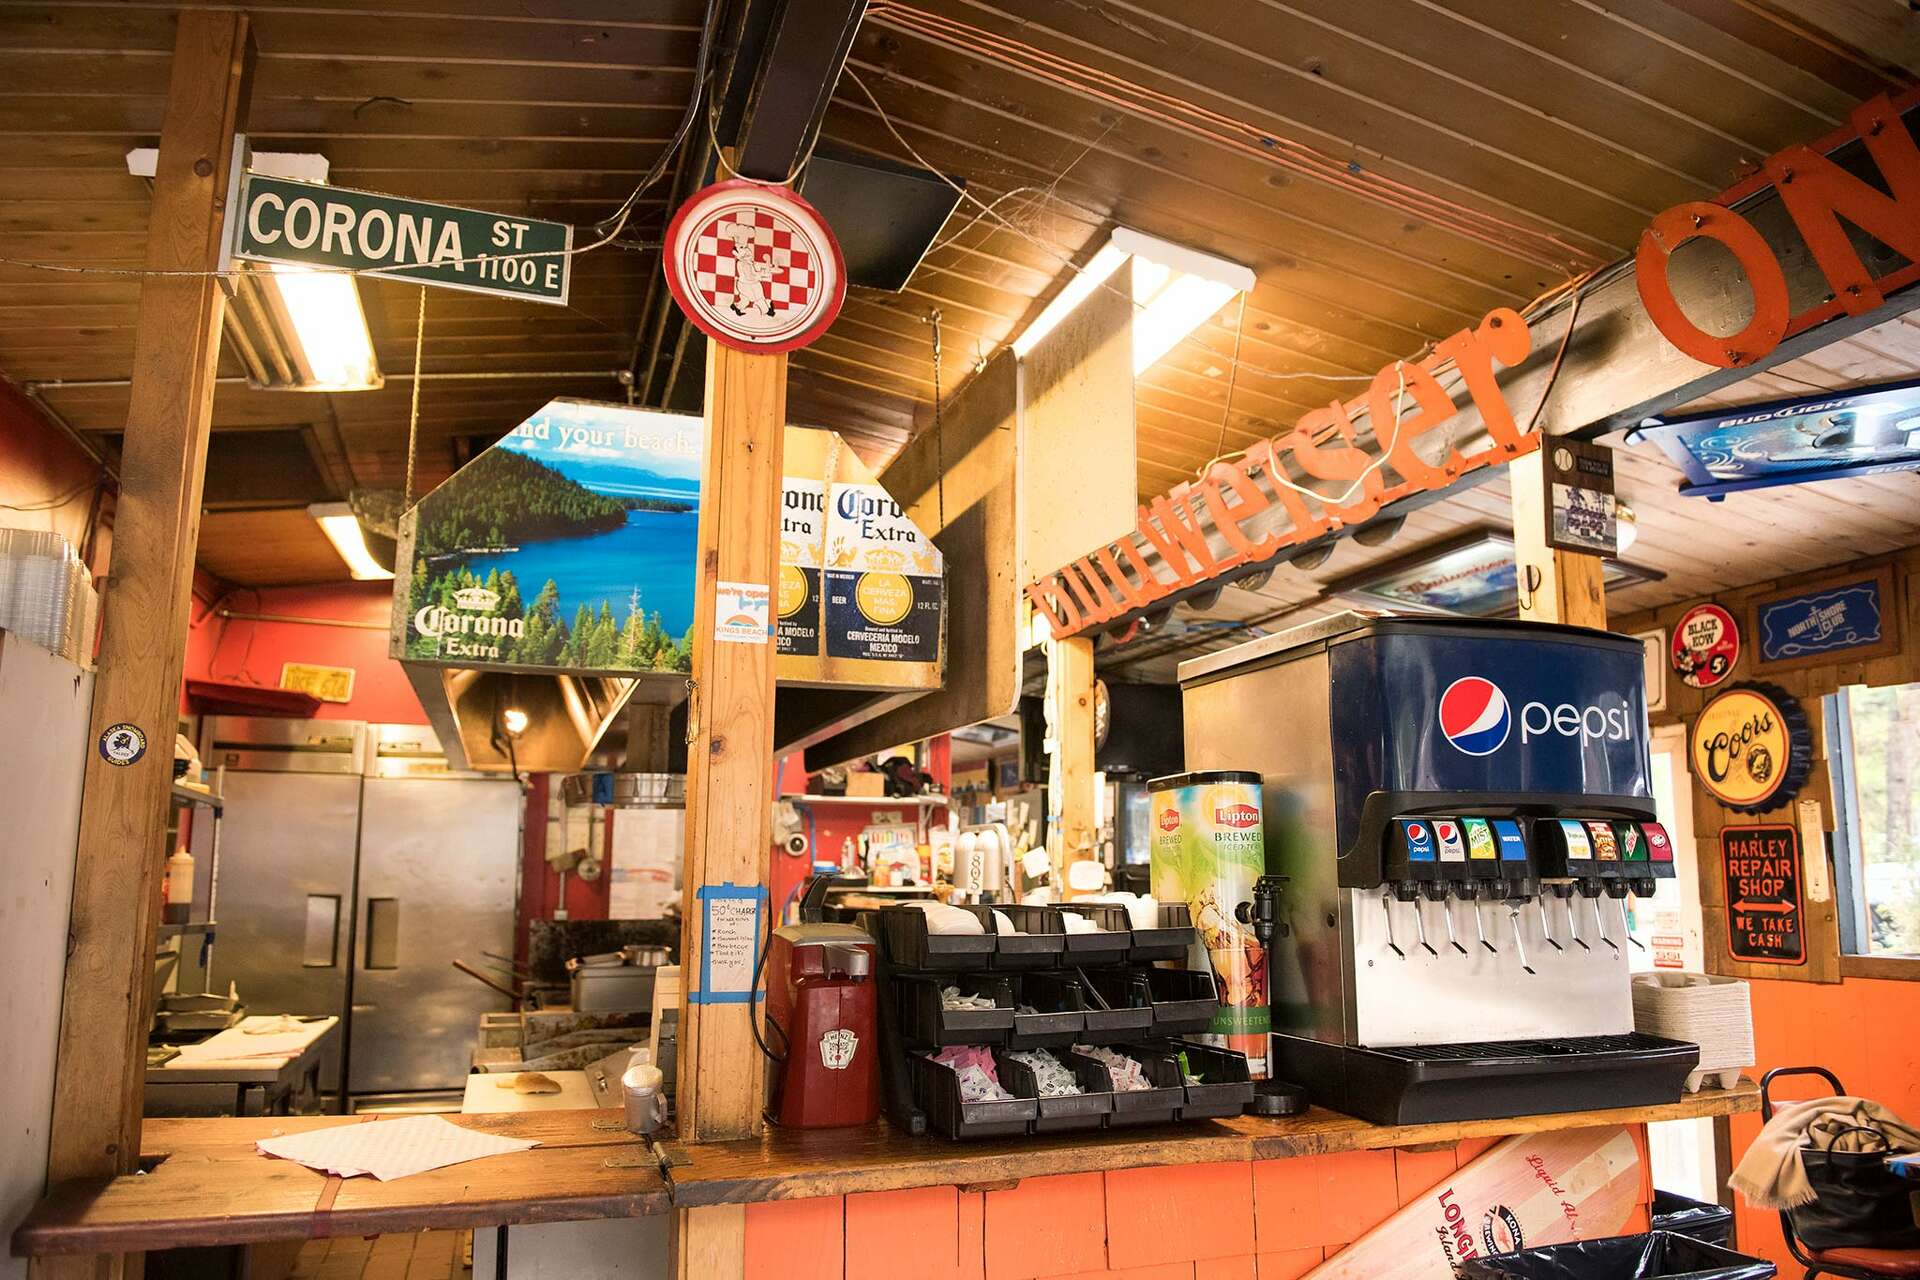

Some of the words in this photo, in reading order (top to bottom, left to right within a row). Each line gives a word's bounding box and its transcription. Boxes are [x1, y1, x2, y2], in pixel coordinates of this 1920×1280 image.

[248, 191, 465, 272] CORONA
[492, 220, 530, 251] ST
[477, 252, 538, 287] 1100
[543, 265, 559, 289] E
[1719, 413, 1774, 428] BUD
[1785, 400, 1856, 417] LIGHT
[554, 427, 615, 451] your
[624, 425, 696, 454] beach.
[837, 488, 911, 524] Coro
[862, 519, 916, 543] Extra
[832, 596, 847, 605] BEER
[414, 605, 524, 640] Corona
[1688, 619, 1718, 636] BLACK
[1787, 615, 1817, 638] NORTH
[1818, 600, 1847, 621] SHORE
[1822, 613, 1845, 631] CLUB
[785, 627, 815, 638] MODELO
[891, 634, 920, 645] MODELO
[447, 637, 499, 659] Extra
[870, 642, 898, 653] MEXICO
[1521, 700, 1631, 748] pepsi
[1703, 711, 1773, 783] Coors
[1220, 808, 1259, 824] Lipton
[1215, 832, 1262, 842] BREWED
[1471, 828, 1487, 845] MIST
[1729, 840, 1787, 858] HARLEY
[1729, 860, 1792, 878] REPAIR
[1739, 879, 1784, 896] SHOP
[1736, 917, 1753, 931] WE
[1762, 918, 1794, 933] TAKE
[1749, 933, 1783, 948] CASH
[1525, 1154, 1565, 1197] Liquid
[1506, 1214, 1521, 1245] KONA
[1436, 1226, 1461, 1271] Island
